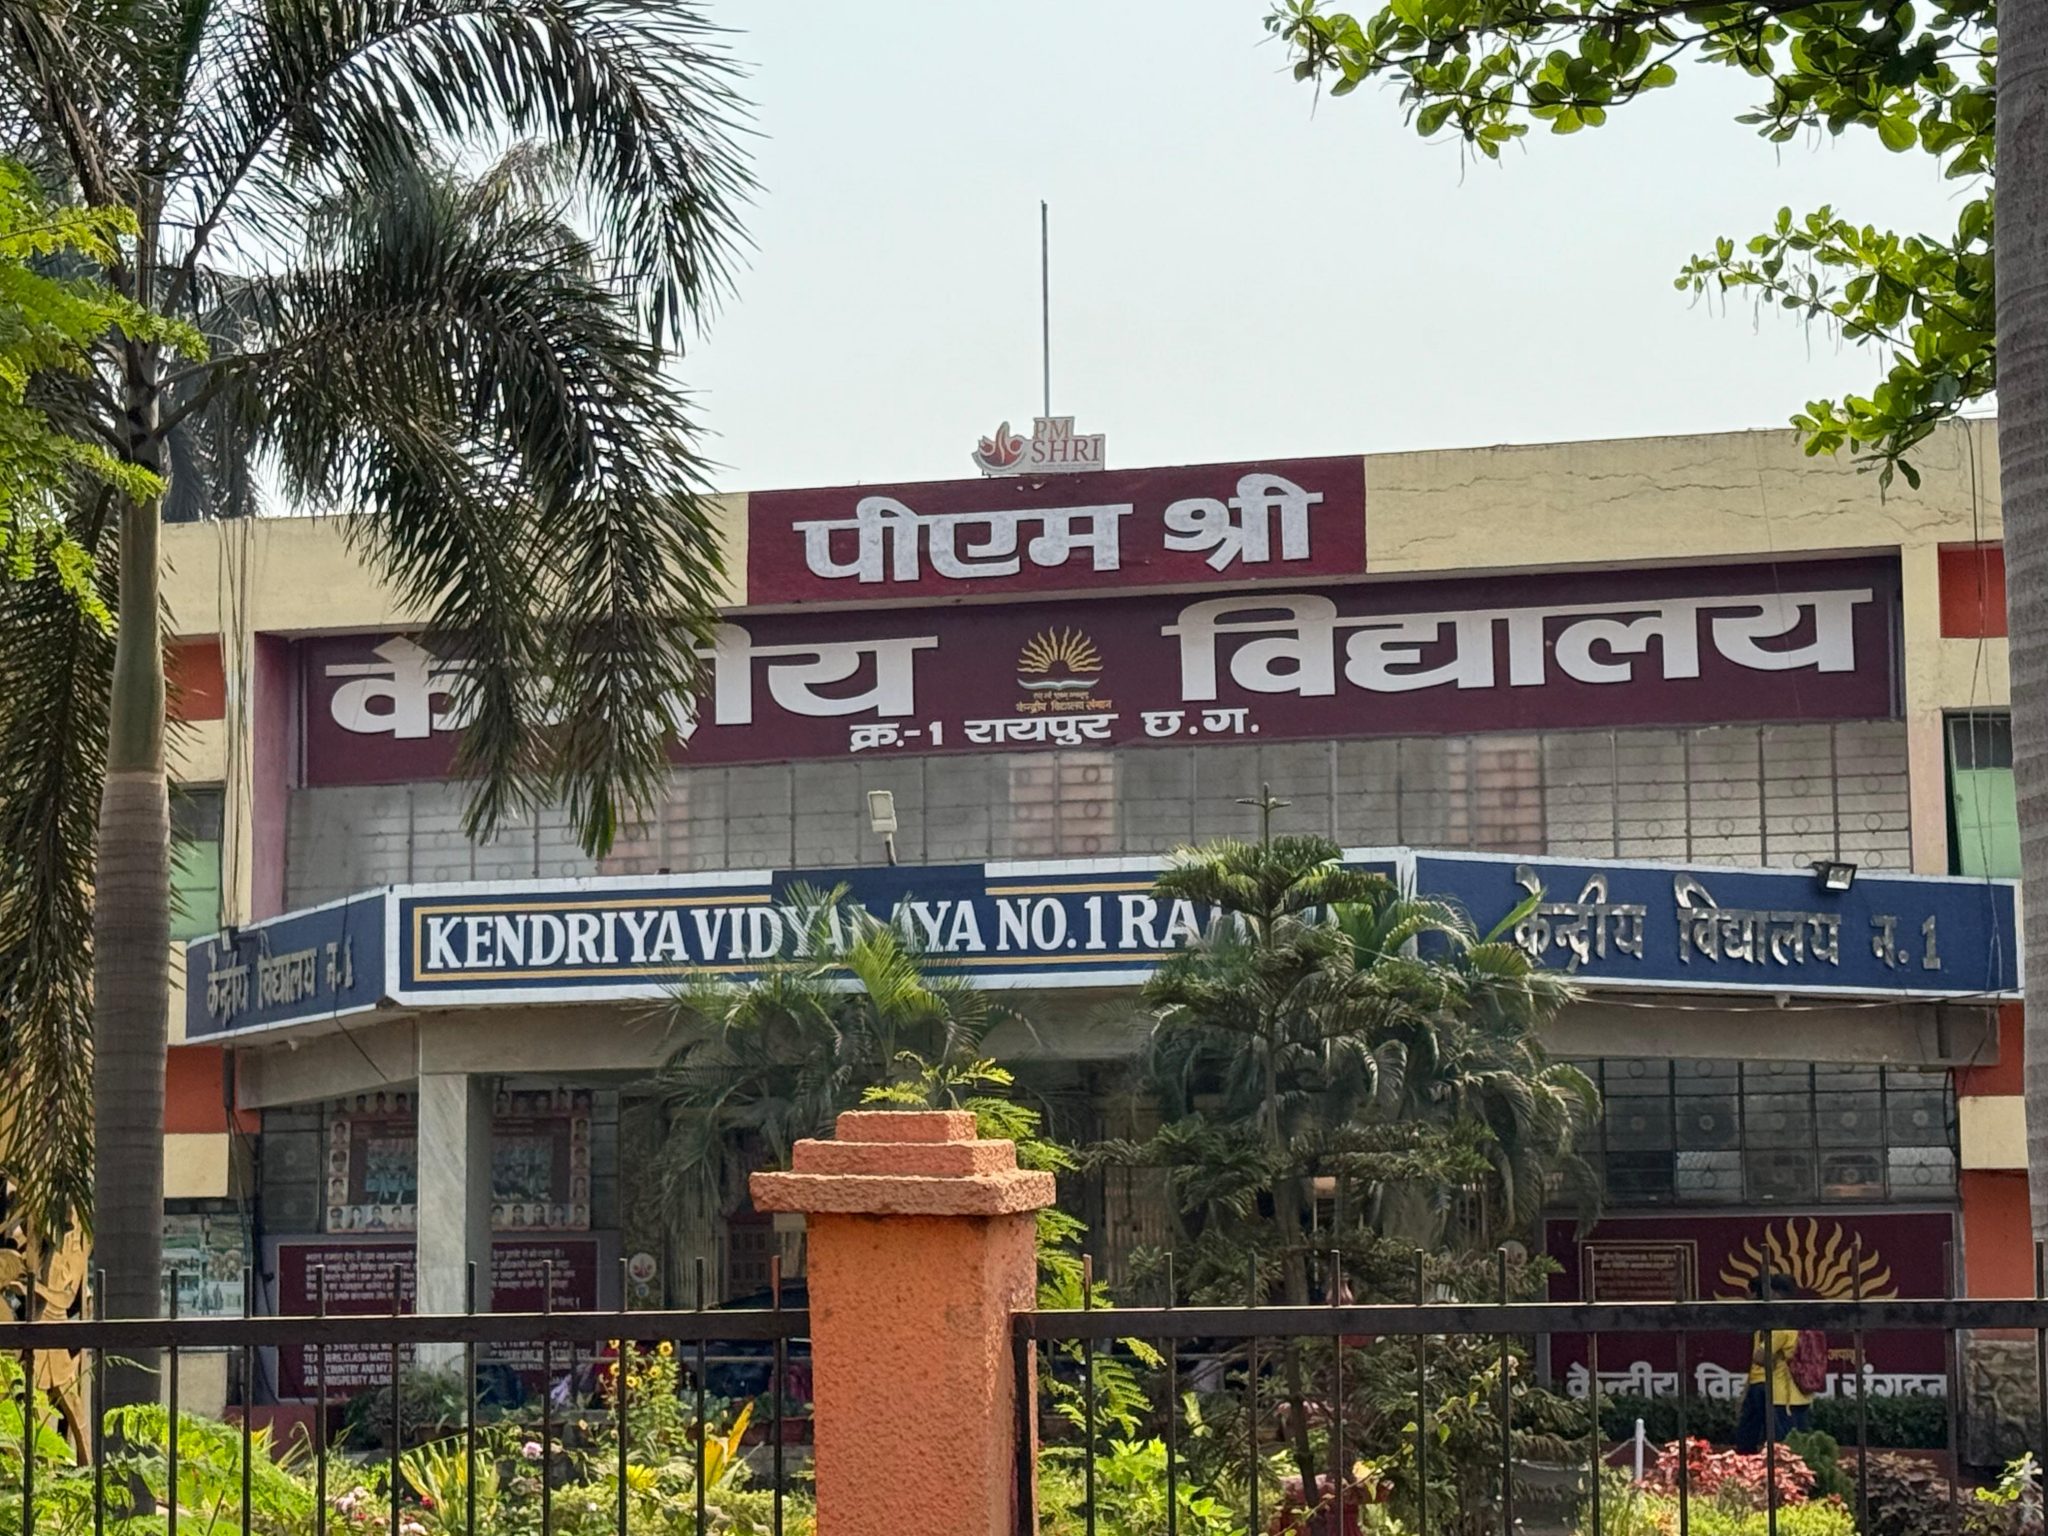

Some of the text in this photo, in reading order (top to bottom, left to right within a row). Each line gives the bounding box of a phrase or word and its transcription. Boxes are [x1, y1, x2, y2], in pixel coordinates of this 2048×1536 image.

[1031, 438, 1101, 463] SHRI
[1034, 419, 1070, 440] PM
[793, 473, 1323, 582] पीएम श्री
[1161, 587, 1874, 702] विद्यालय
[964, 712, 1120, 746] रायपुर
[1673, 873, 1841, 967] विद्यालय
[1921, 914, 1942, 971] 1
[257, 928, 318, 1011] विद्यालय
